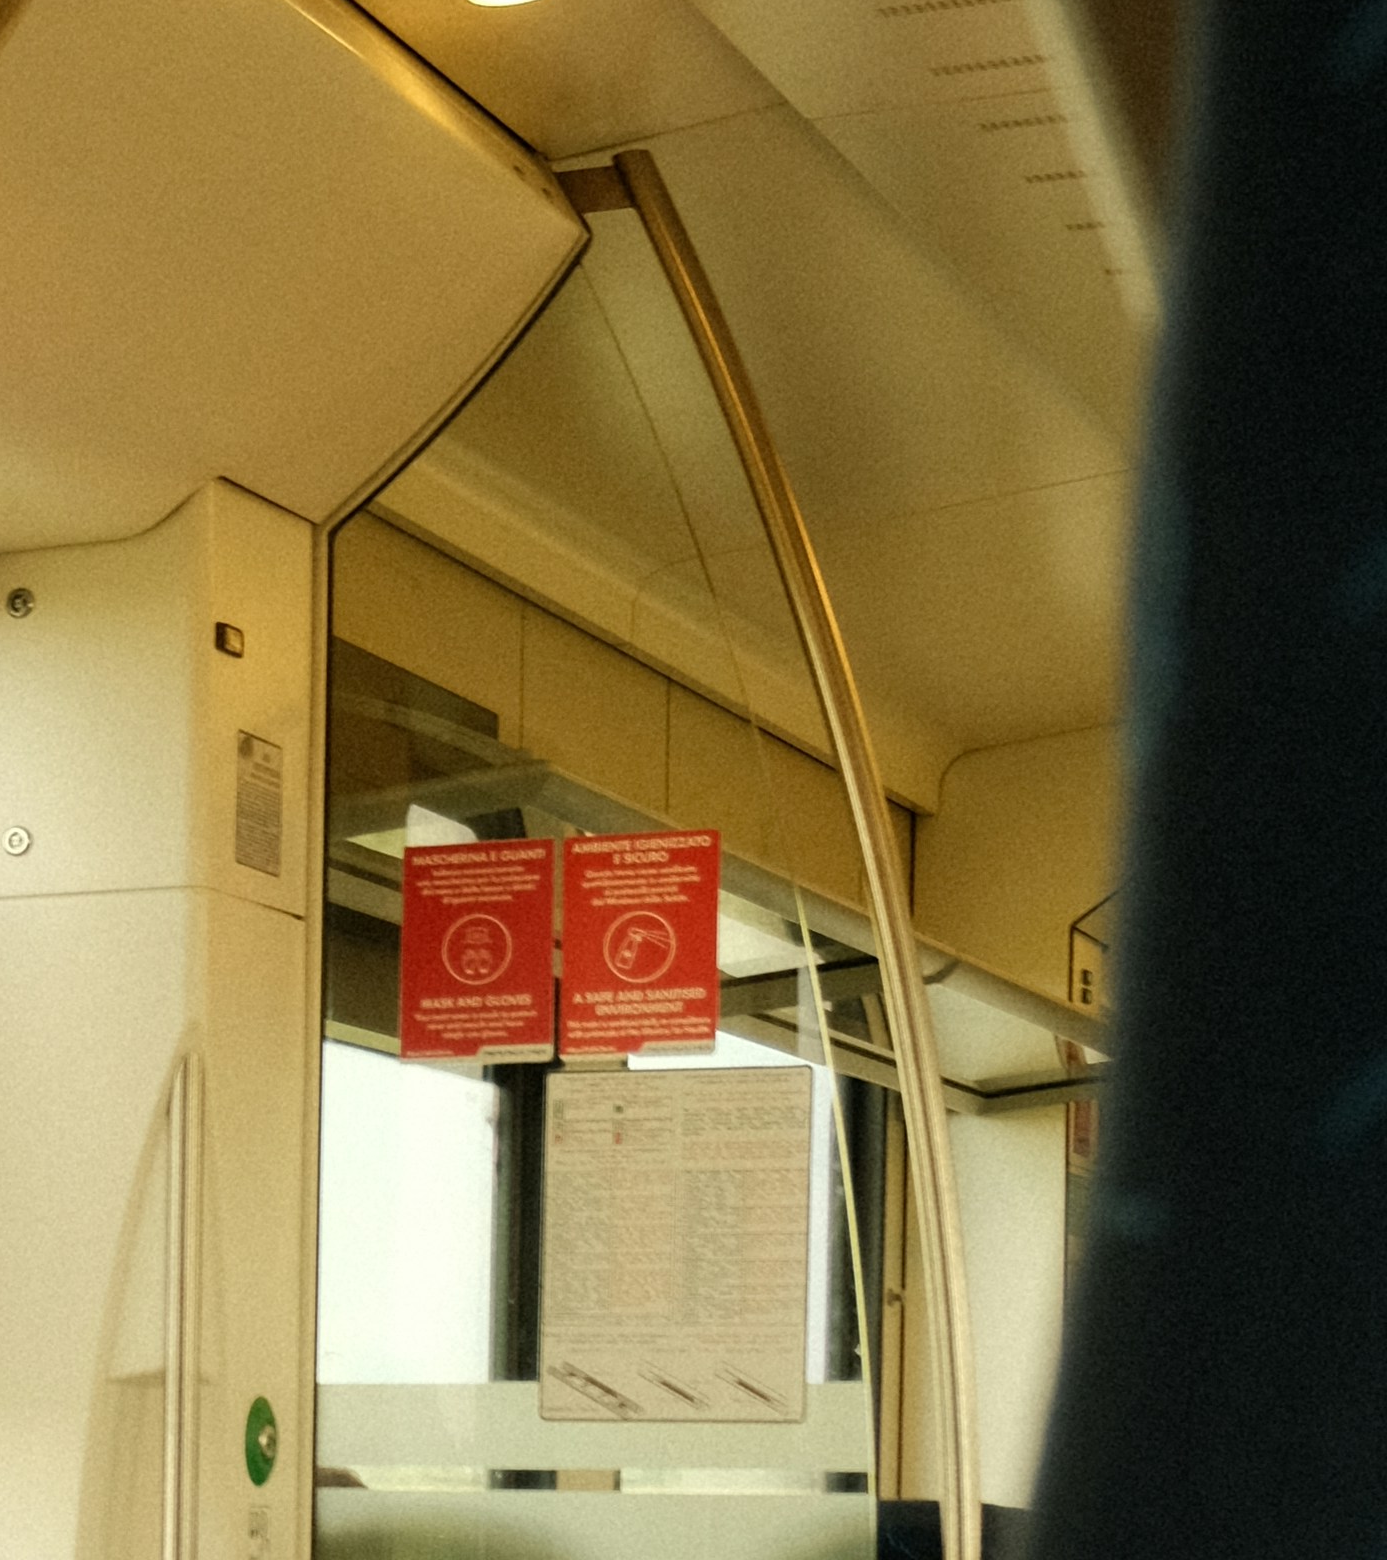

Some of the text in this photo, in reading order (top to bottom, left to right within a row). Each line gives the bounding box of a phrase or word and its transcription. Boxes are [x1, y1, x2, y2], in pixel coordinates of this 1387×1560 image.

[571, 840, 632, 854] AMBIENTE
[411, 852, 488, 866] MASCHERINA
[500, 848, 546, 862] GUANTI
[622, 851, 669, 864] SICURO
[420, 997, 455, 1009] MASK
[456, 996, 483, 1008] AND
[616, 990, 644, 1002] AND
